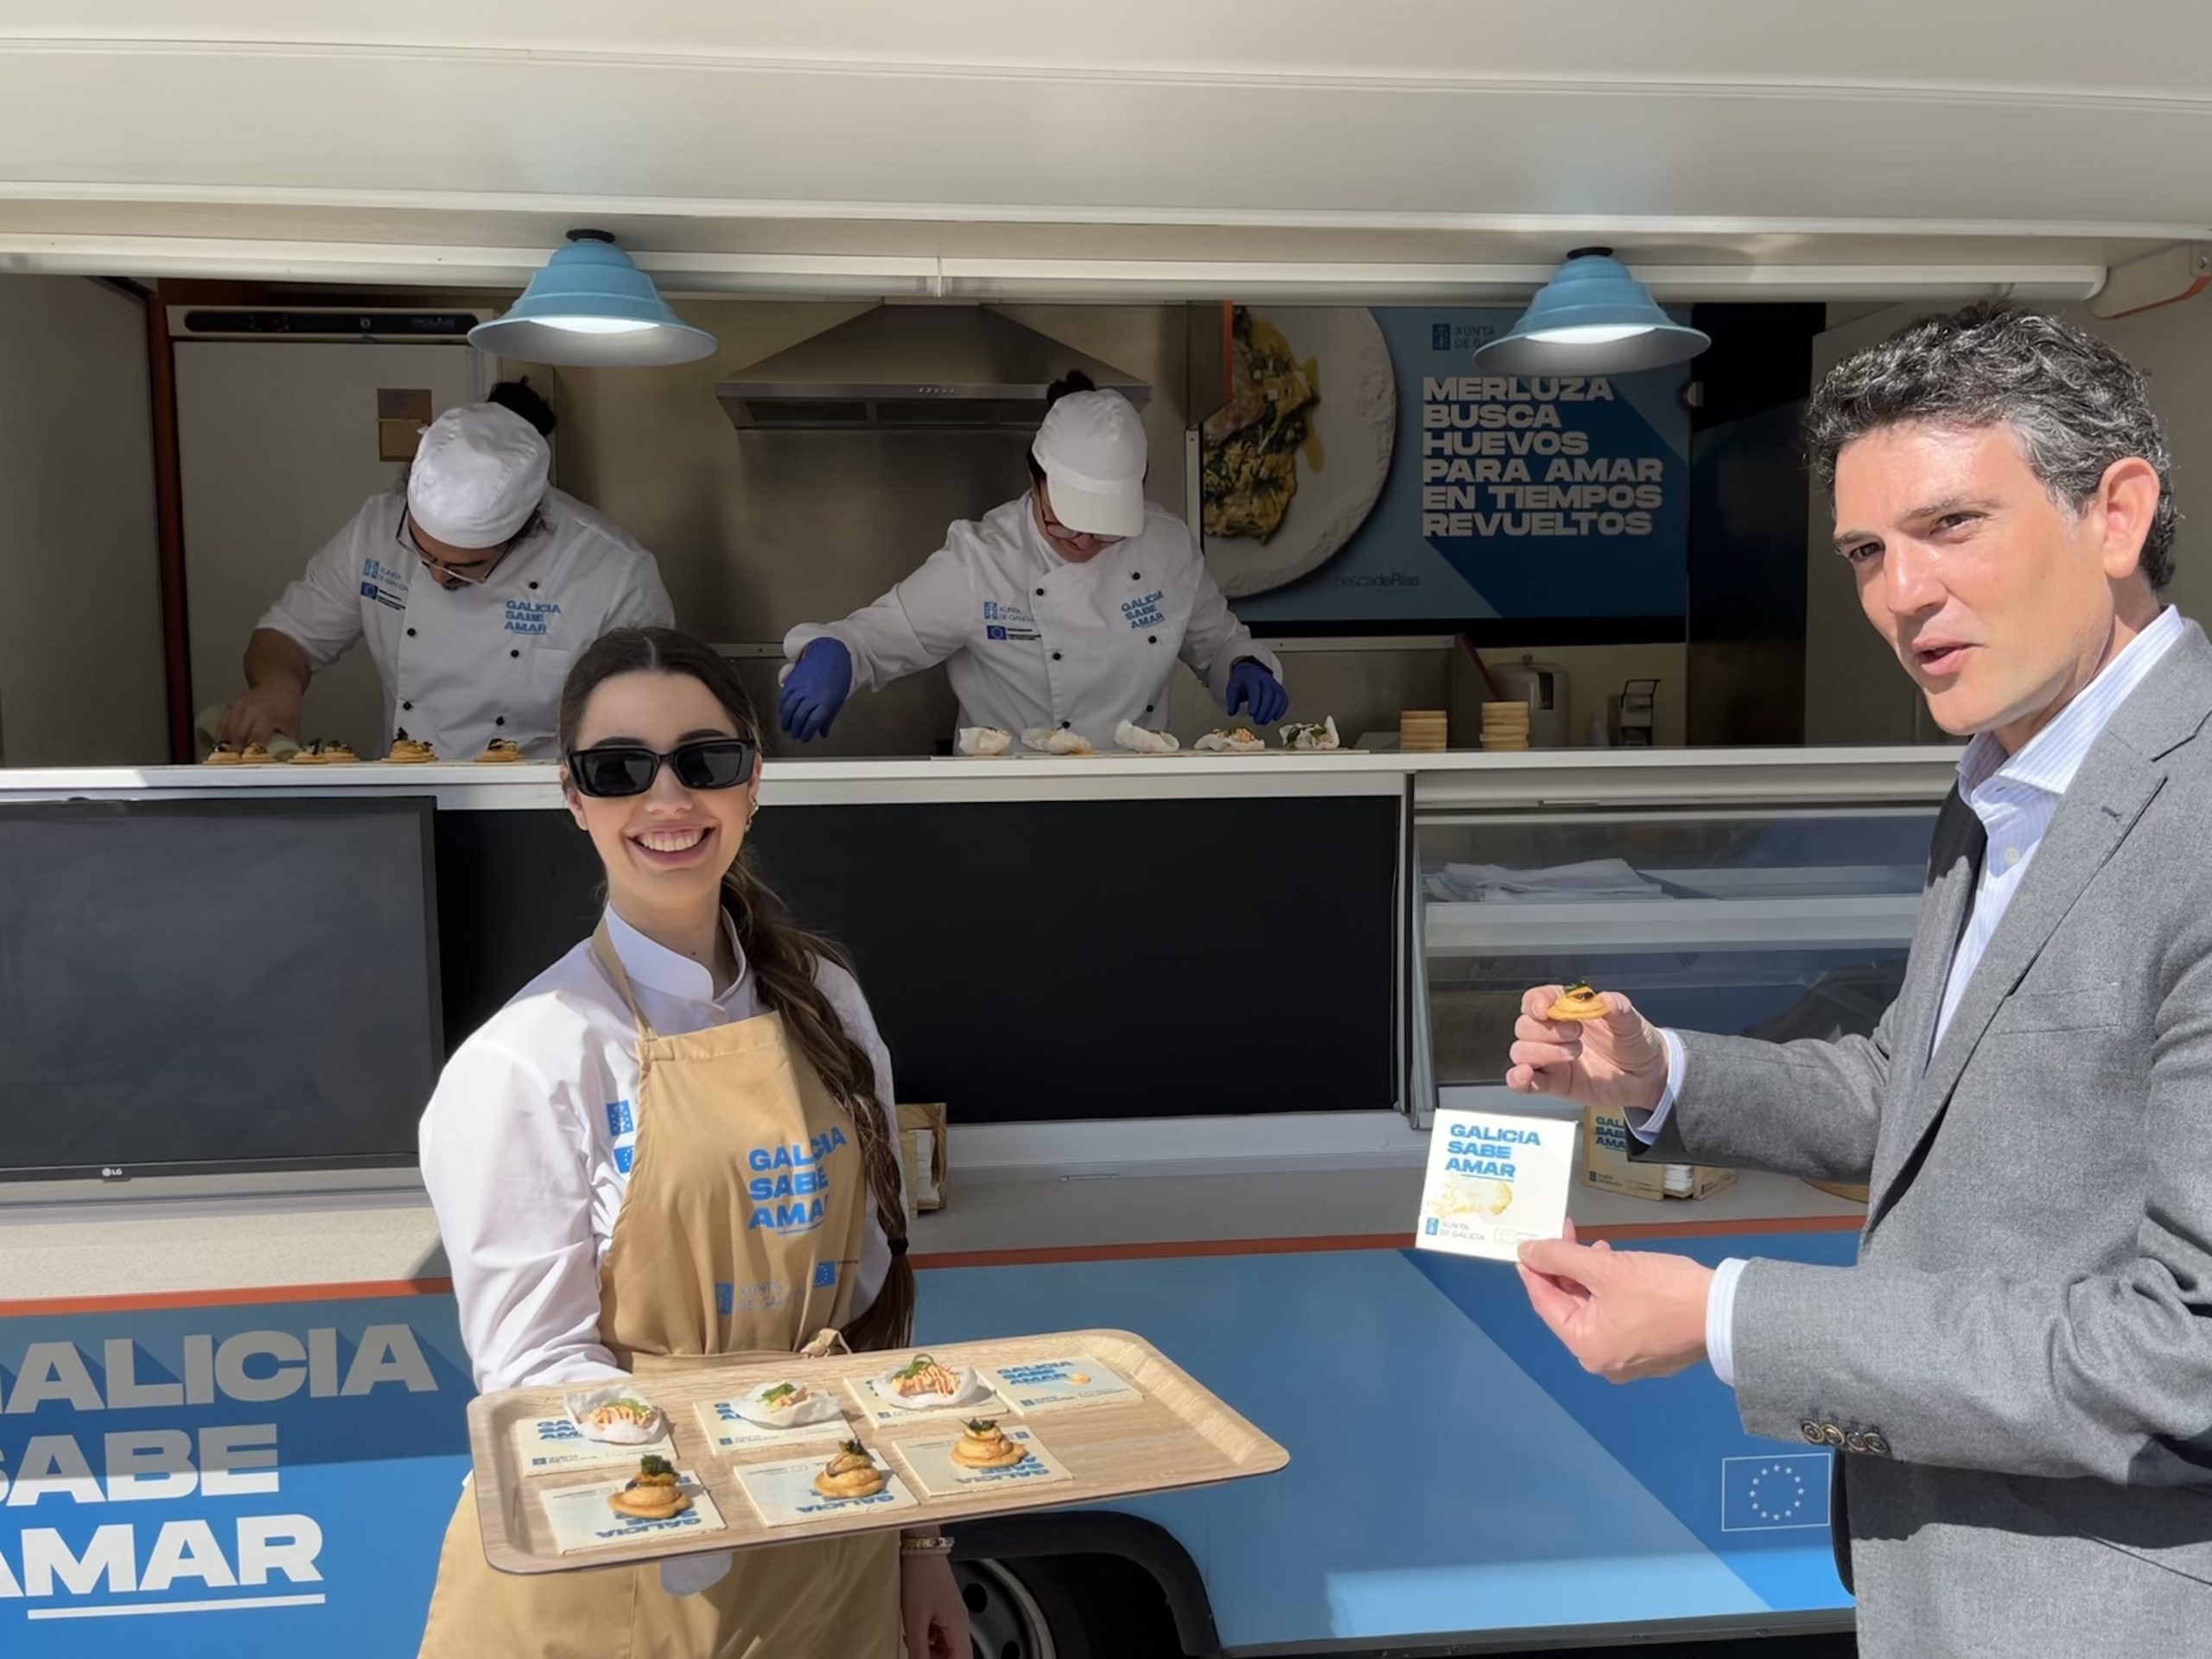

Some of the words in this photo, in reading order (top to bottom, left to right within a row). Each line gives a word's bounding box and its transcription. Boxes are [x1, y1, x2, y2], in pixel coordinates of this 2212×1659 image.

[1455, 326, 1496, 336] XUNTA
[1454, 339, 1473, 349] DE
[1423, 377, 1614, 402] MERLUZA
[1423, 404, 1562, 429] BUSCA
[1423, 430, 1589, 456] HUEVOS
[1422, 458, 1532, 483] PARA
[1544, 458, 1664, 482] AMAR
[1422, 486, 1476, 510] EN
[1488, 484, 1664, 510] TIEMPOS
[1422, 512, 1653, 537] REVUELTOS
[505, 600, 561, 614] GALICIA
[1121, 590, 1165, 612] GALICIA
[505, 610, 544, 622] SABE
[1125, 604, 1159, 620] SABE
[1130, 612, 1166, 629] AMAR
[504, 621, 547, 633] AMAR
[1450, 1124, 1541, 1146] GALICIA
[1595, 1127, 1626, 1139] SAB
[1595, 1137, 1628, 1148] AMA
[1447, 1141, 1511, 1160] SABE
[1445, 1157, 1516, 1178] AMAR
[748, 1165, 830, 1201] SABE
[748, 1192, 830, 1230] AMA
[0, 1323, 439, 1414] ALICIA
[0, 1423, 279, 1507] ABE
[595, 1518, 701, 1538] GALICIA
